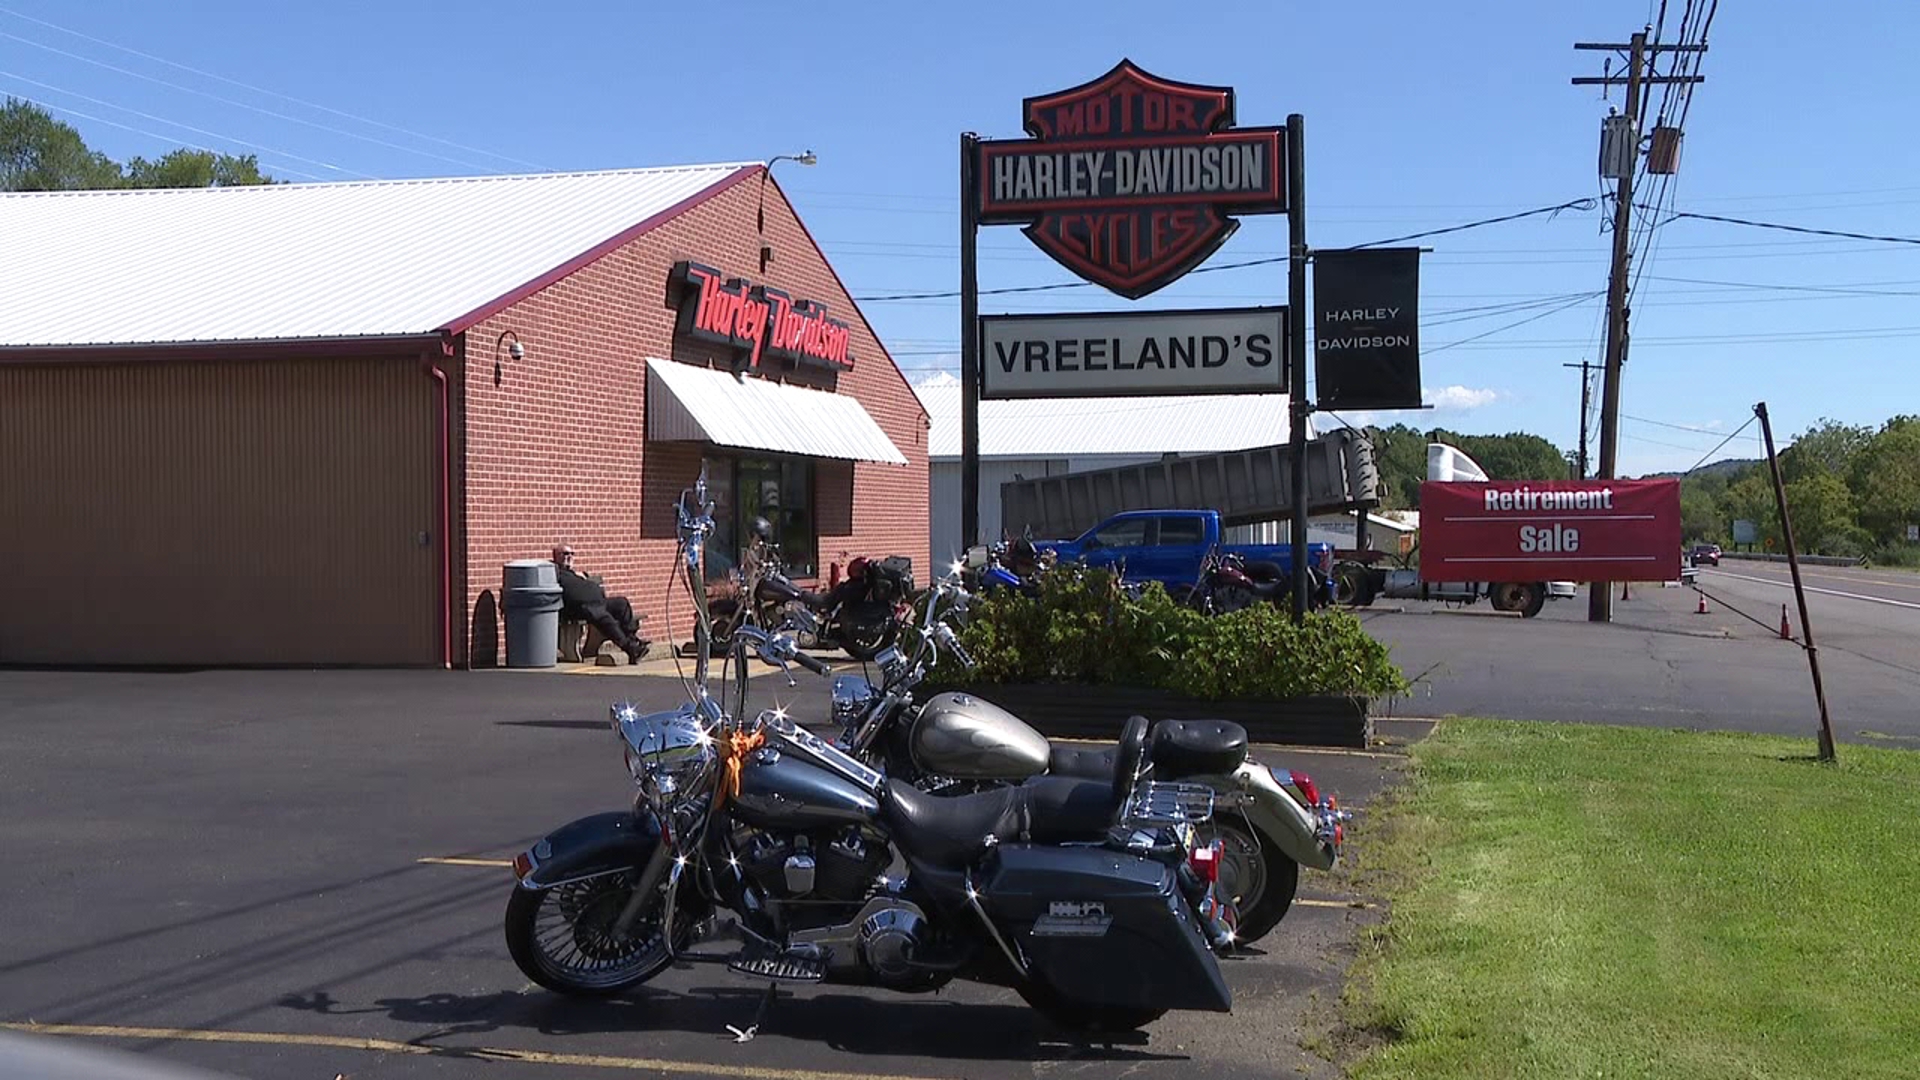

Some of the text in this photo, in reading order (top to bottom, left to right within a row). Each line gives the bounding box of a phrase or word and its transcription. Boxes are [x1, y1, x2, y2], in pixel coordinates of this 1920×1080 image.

[1056, 87, 1199, 135] MOTOR
[993, 143, 1264, 201] HARLEY-DAVIDSON
[1059, 208, 1196, 274] CYCLES
[1325, 306, 1400, 322] HARLEY
[994, 333, 1273, 373] VREELAND'S
[1317, 334, 1411, 350] DAVIDSON
[1484, 486, 1614, 511] Retirement
[1519, 523, 1579, 553] Sale
